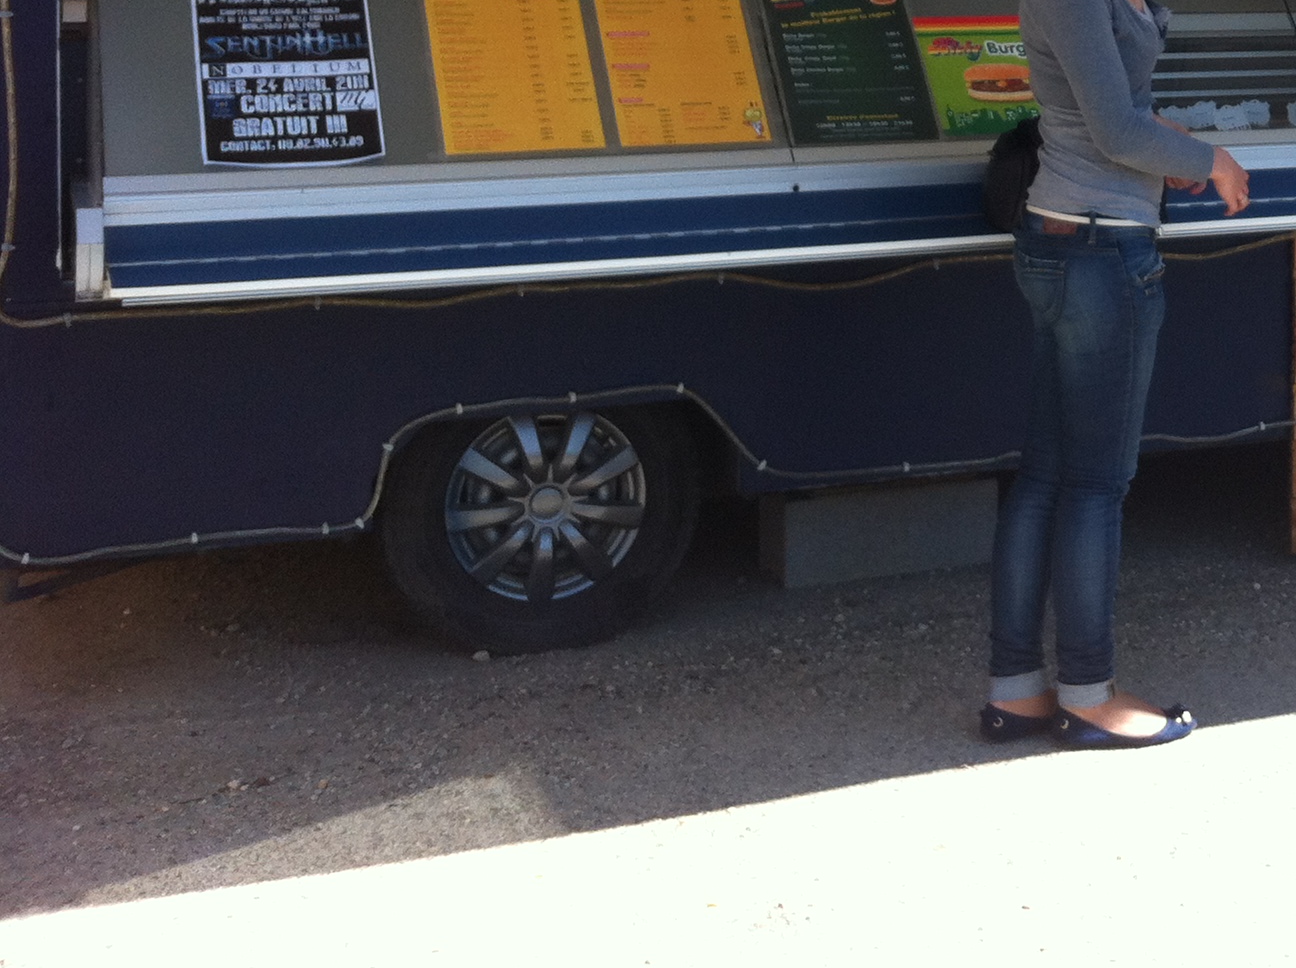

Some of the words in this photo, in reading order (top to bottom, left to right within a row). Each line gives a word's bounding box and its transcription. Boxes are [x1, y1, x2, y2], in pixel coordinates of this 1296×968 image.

[211, 62, 361, 76] NOBELIUM
[256, 78, 279, 93] 24
[240, 92, 334, 114] CONCERT
[233, 116, 320, 138] GRATUIT
